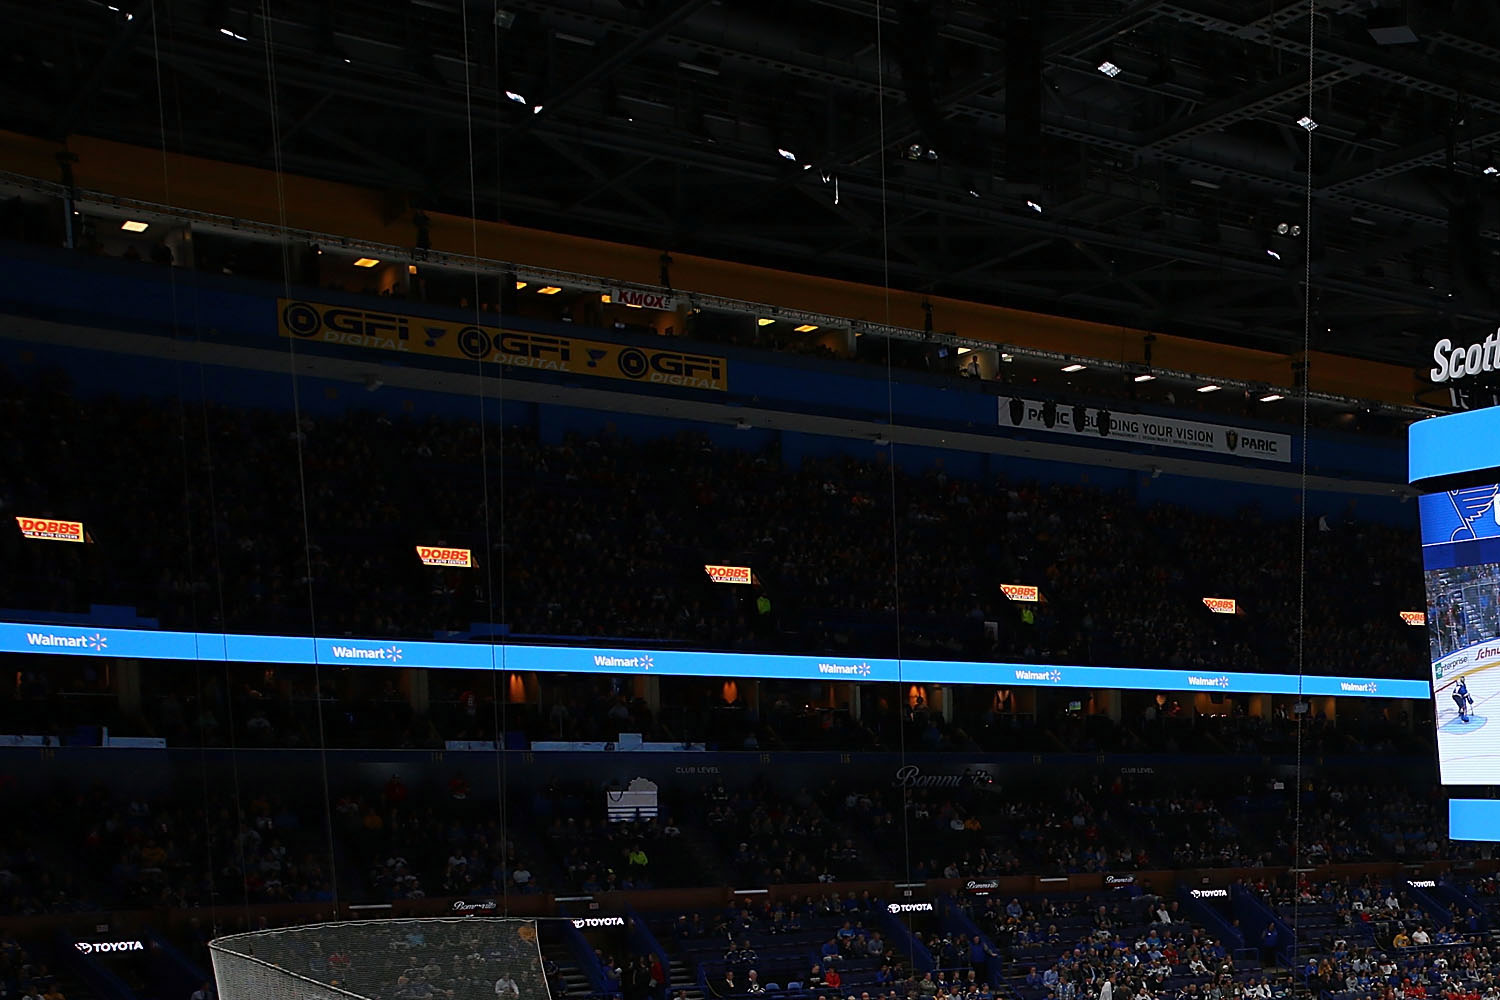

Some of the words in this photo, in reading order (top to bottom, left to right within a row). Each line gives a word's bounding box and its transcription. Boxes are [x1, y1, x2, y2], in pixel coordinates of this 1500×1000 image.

[619, 291, 665, 308] KMOX
[325, 331, 409, 352] DIGITAL
[494, 353, 570, 373] DIGITAL
[651, 373, 721, 390] DIGITAL
[1028, 408, 1070, 425] PIC
[1083, 411, 1138, 433] BUDING
[1142, 422, 1173, 437] YOUR
[1176, 428, 1214, 443] VISION
[1241, 437, 1277, 452] PARIC
[22, 519, 80, 535] DOBBS
[421, 549, 469, 561] DOBBS
[709, 567, 749, 578] DOBBS
[27, 633, 88, 648] Walmart
[333, 646, 386, 660] Walmart
[594, 655, 639, 668] Walmart
[818, 663, 859, 675] Walmart
[1015, 670, 1051, 682] Walmart
[1187, 676, 1219, 688] Walmart
[1340, 682, 1369, 692] Walmart
[1201, 889, 1228, 897] TOYOTA
[901, 904, 933, 912] TOYOTA
[584, 917, 625, 927] TOYOTA
[94, 941, 144, 953] TOYOTA
